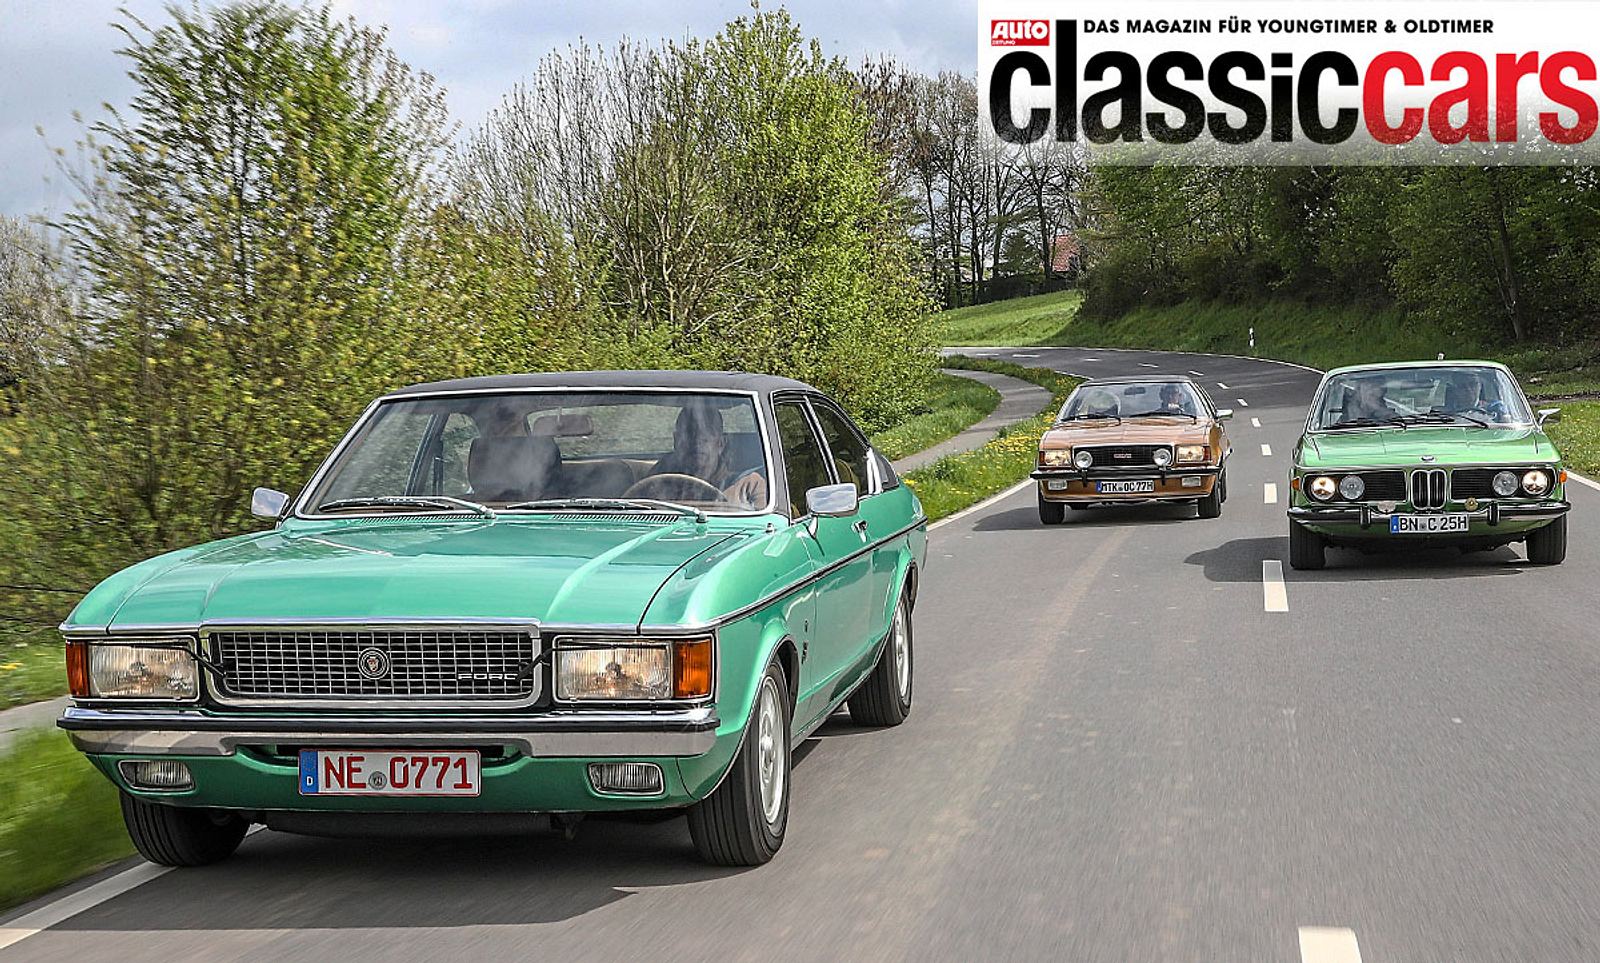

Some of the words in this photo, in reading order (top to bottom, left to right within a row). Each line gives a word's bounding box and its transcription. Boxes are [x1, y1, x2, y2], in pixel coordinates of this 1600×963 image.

[1400, 517, 1418, 531] BN
[324, 756, 367, 789] NE
[389, 756, 473, 789] 0771
[305, 776, 314, 786] D
